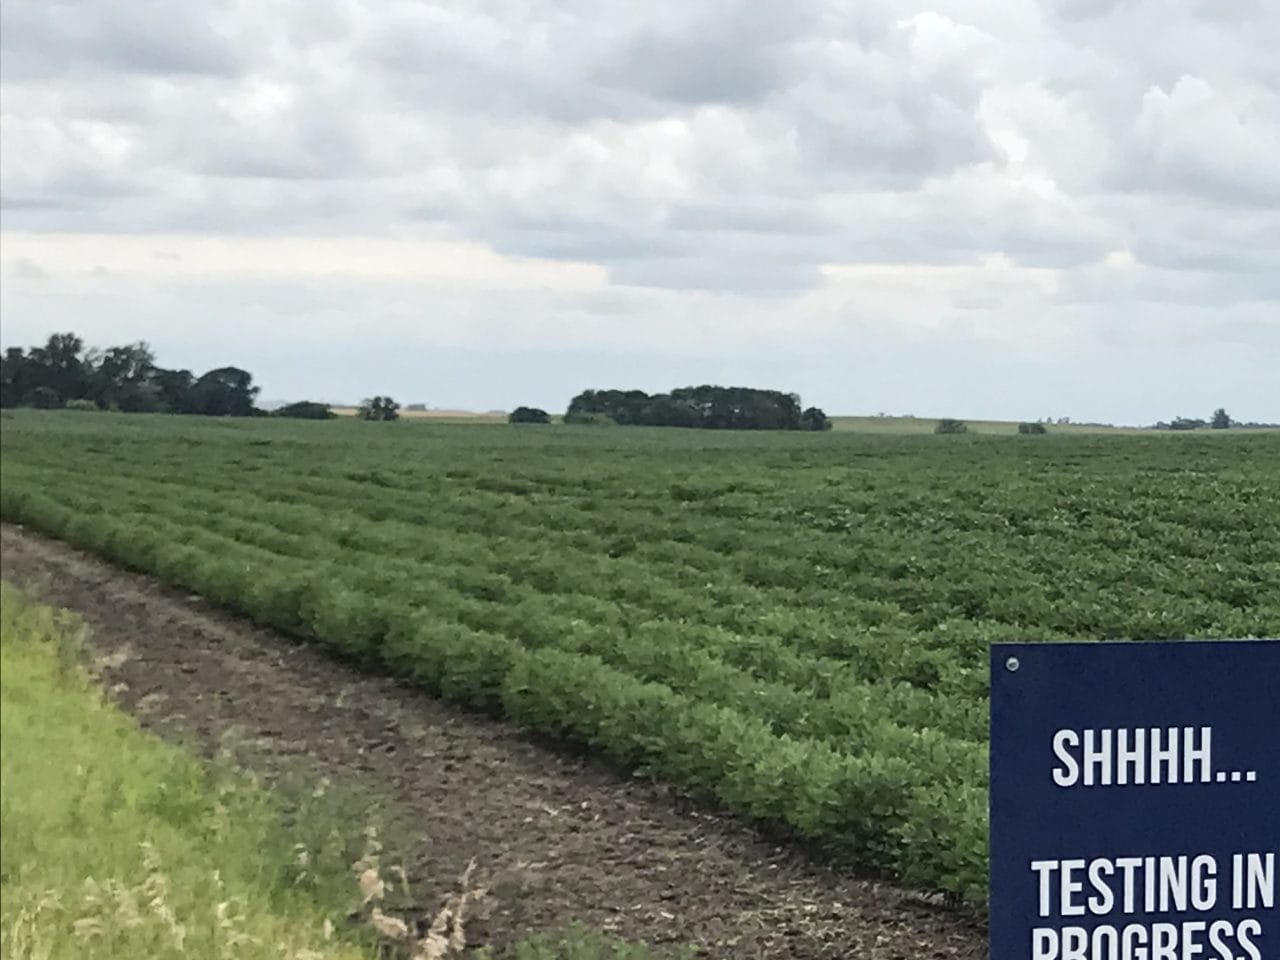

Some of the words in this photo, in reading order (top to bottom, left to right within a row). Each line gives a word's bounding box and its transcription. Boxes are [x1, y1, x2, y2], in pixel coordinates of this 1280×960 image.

[1052, 726, 1257, 787] SHHHH...
[1030, 854, 1217, 917] TESTING
[1232, 852, 1275, 909] IN
